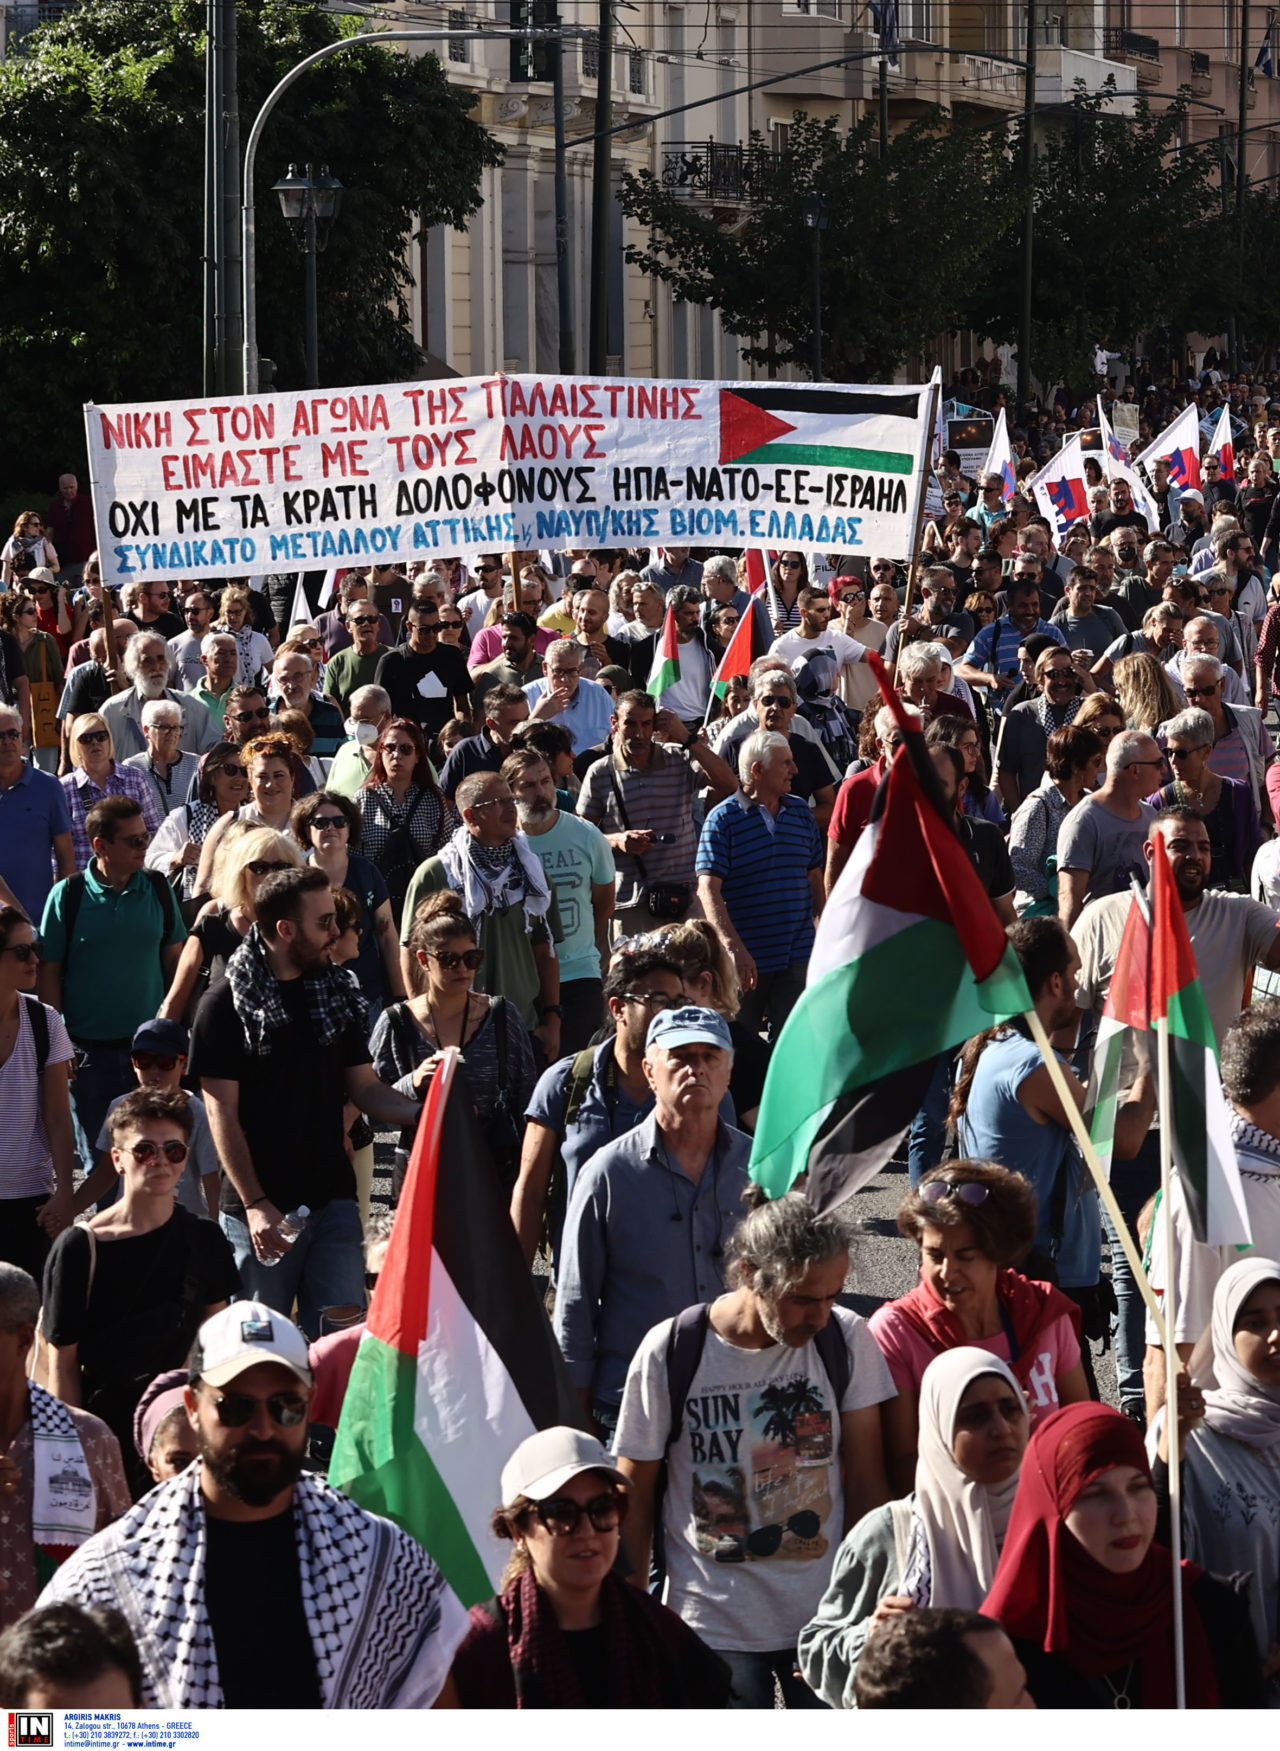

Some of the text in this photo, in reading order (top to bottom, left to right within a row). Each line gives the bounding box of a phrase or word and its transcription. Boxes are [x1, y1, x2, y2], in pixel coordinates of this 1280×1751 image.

[101, 380, 702, 450] ΝΙΚΗ ΣΤΟΝ ΑΓΩΝΑ ΤΗΣ ΠΑΛΑΙΣΤΙΝΗΣ
[161, 423, 606, 491] ΕΙΜΑΣΤΕ ΜΕ ΤΟΥΣ ΛΑΟΥΣ
[109, 500, 160, 538] ΟΧΙ
[176, 496, 221, 534] ΜΕ
[231, 493, 270, 529] ΤΑ
[283, 483, 378, 526] ΚΡΑΤΗ
[395, 465, 596, 516] ΔΟΛΟΦΟΝΟΥΣ
[114, 536, 256, 573] ΣΥΝΔΙΚΑΤΟ
[269, 524, 401, 561] ΜΕΤΑΛΛΟΥ
[412, 511, 520, 549] ΑΤΤΙΚΗΣ
[535, 504, 660, 544] ΝΑΥΠ/ΚΗΣ
[815, 564, 836, 573] FIL
[538, 848, 582, 870] EAL
[685, 1393, 742, 1431] SUN
[689, 1429, 744, 1465] BAY
